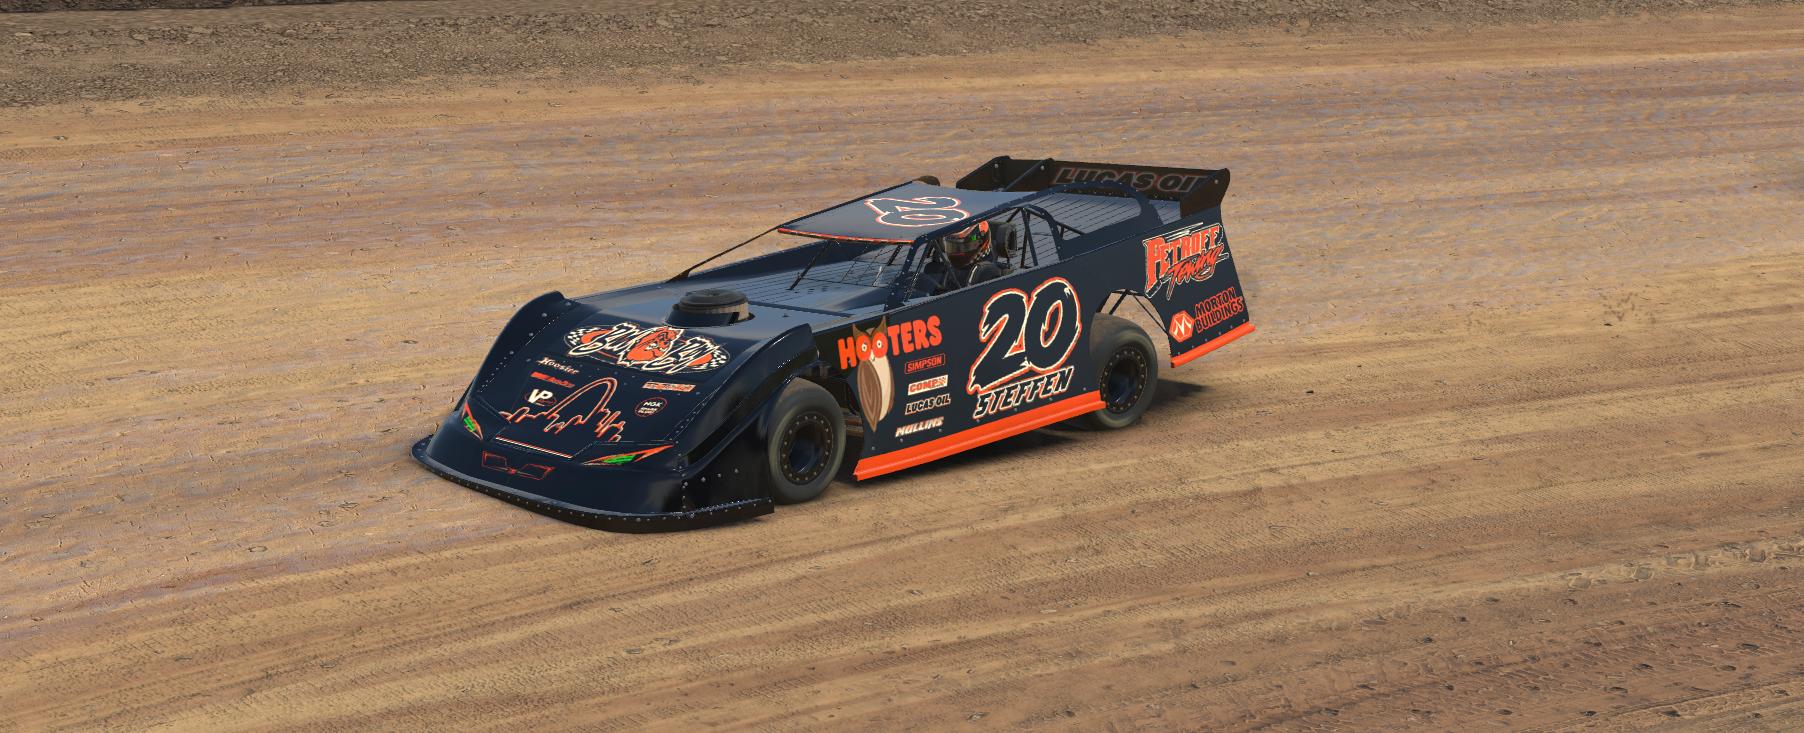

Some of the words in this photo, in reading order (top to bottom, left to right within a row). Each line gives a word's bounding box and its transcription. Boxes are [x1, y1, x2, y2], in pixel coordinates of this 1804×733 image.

[1157, 173, 1207, 192] OI
[864, 196, 971, 228] 20
[1142, 222, 1224, 298] PETROFF
[1194, 286, 1236, 319] MORTON
[1195, 296, 1244, 333] BUILDINGS
[837, 314, 943, 370] HOOTERS
[966, 276, 1082, 395] 20
[536, 357, 580, 375] Hoosier
[906, 356, 942, 373] SIMPSON
[527, 388, 553, 404] VP
[904, 397, 936, 415] LUCAS
[936, 393, 951, 407] OIL
[972, 365, 1074, 420] STEFFEN
